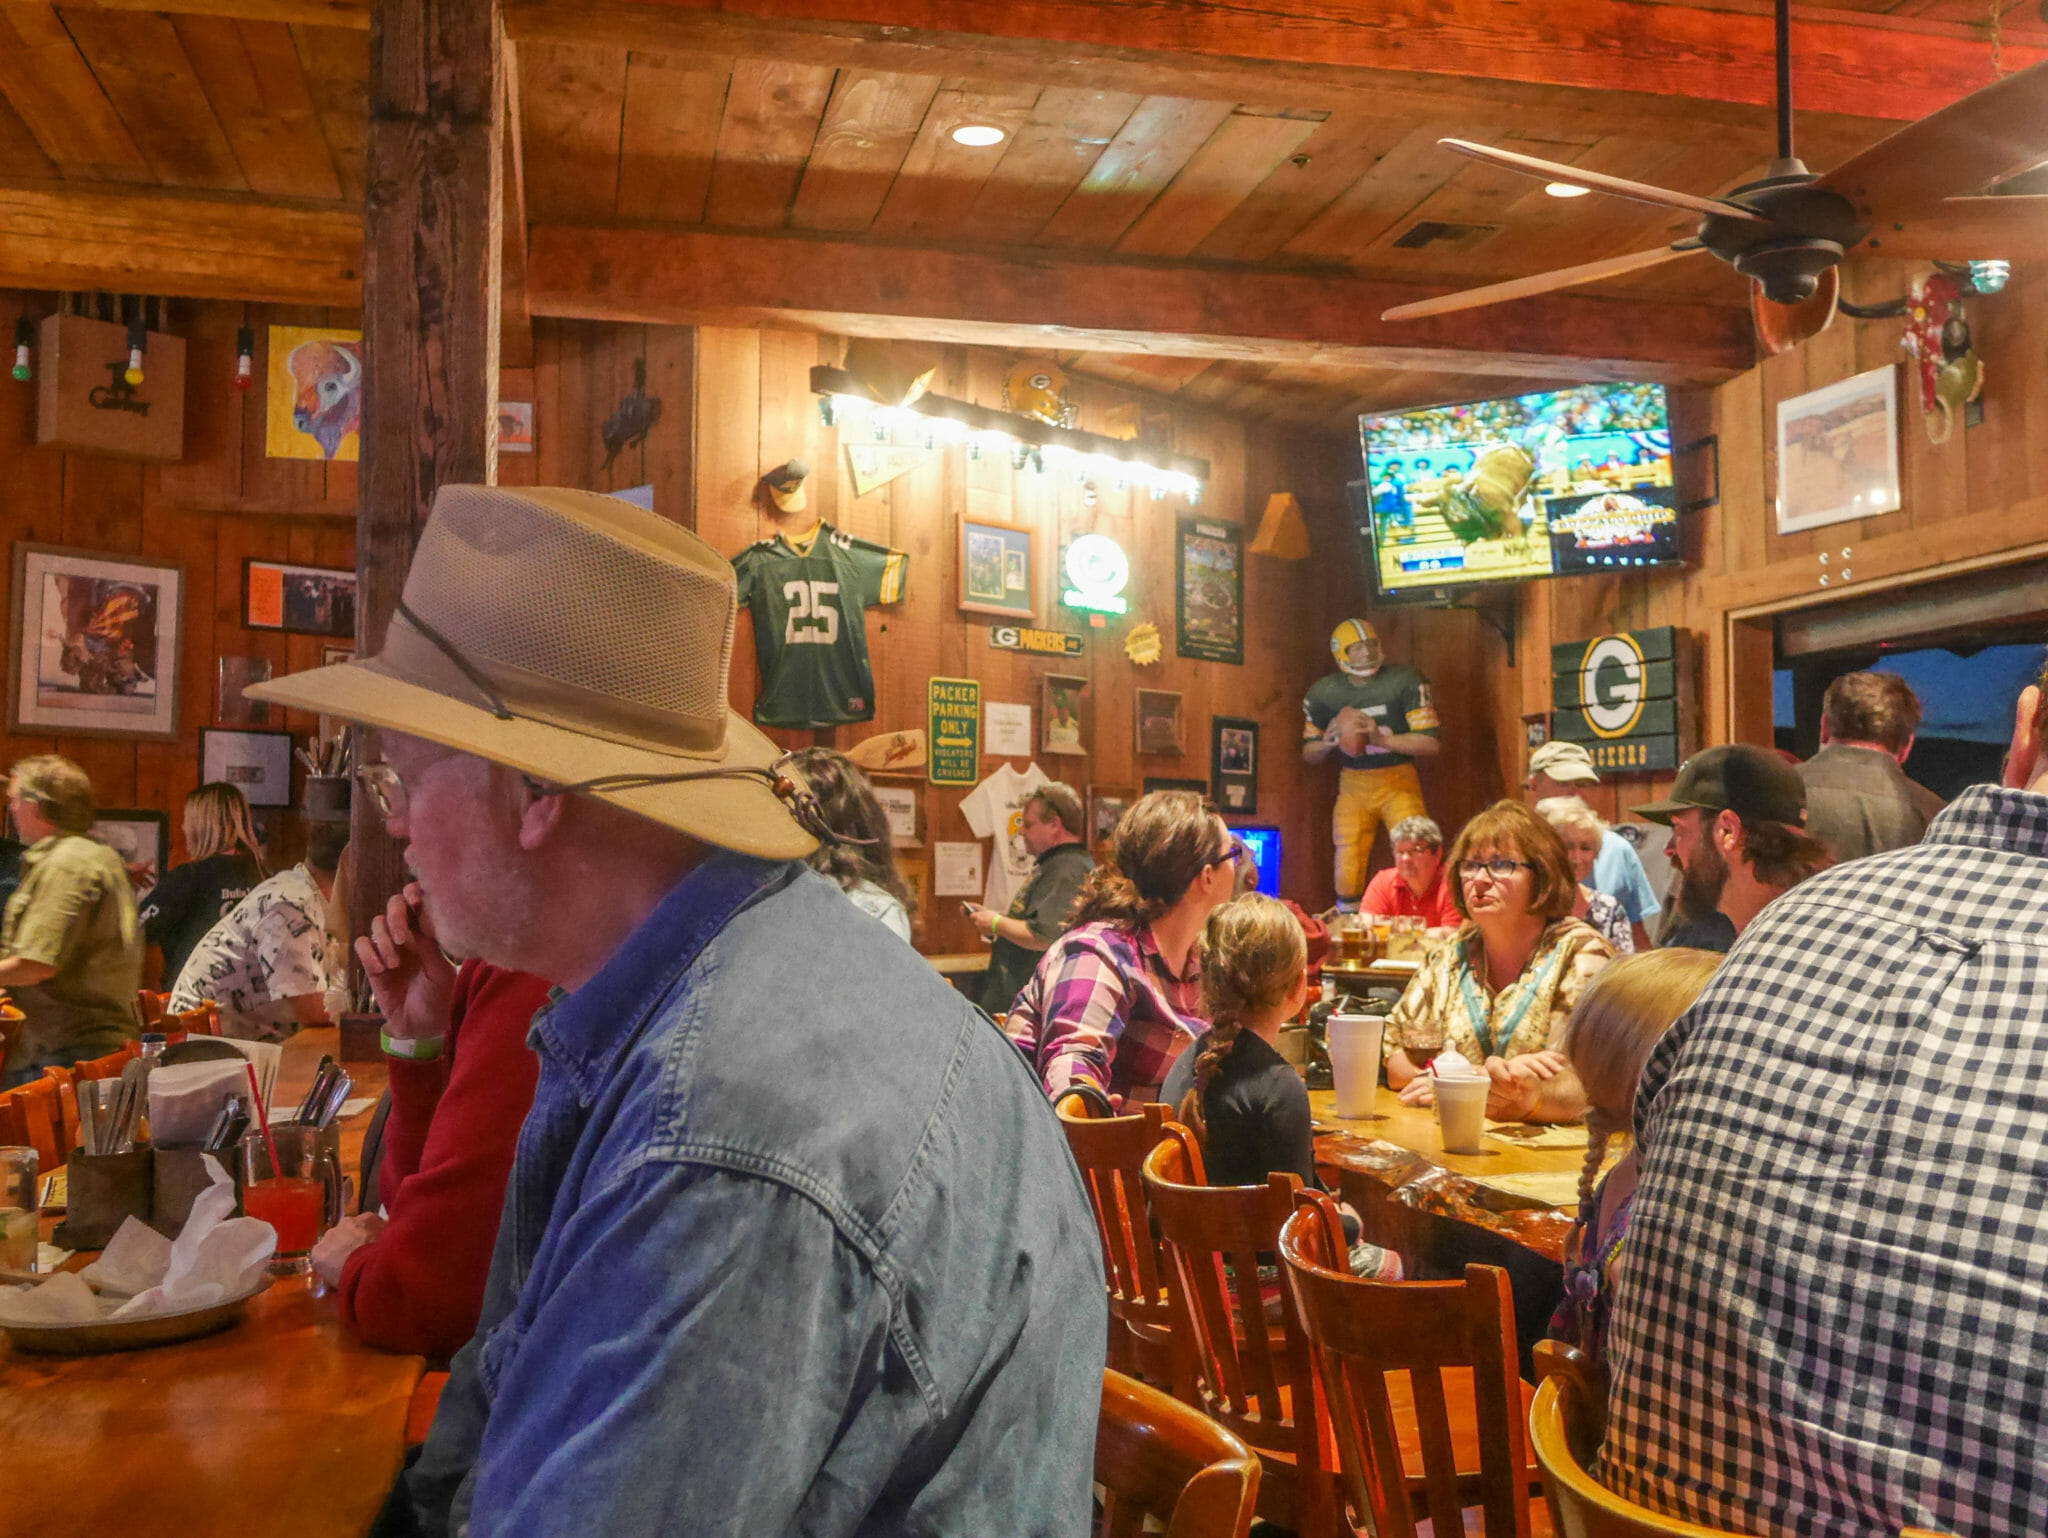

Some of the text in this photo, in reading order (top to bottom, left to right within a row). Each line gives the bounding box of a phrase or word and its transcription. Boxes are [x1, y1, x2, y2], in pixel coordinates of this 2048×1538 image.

[783, 580, 839, 645] 25
[997, 628, 1017, 646] G
[1020, 628, 1066, 652] PACKERS
[933, 685, 976, 701] PACKER
[1584, 639, 1641, 730] G
[933, 702, 977, 719] PARKING
[941, 720, 968, 735] ONLY
[1588, 744, 1648, 767] ACKERS
